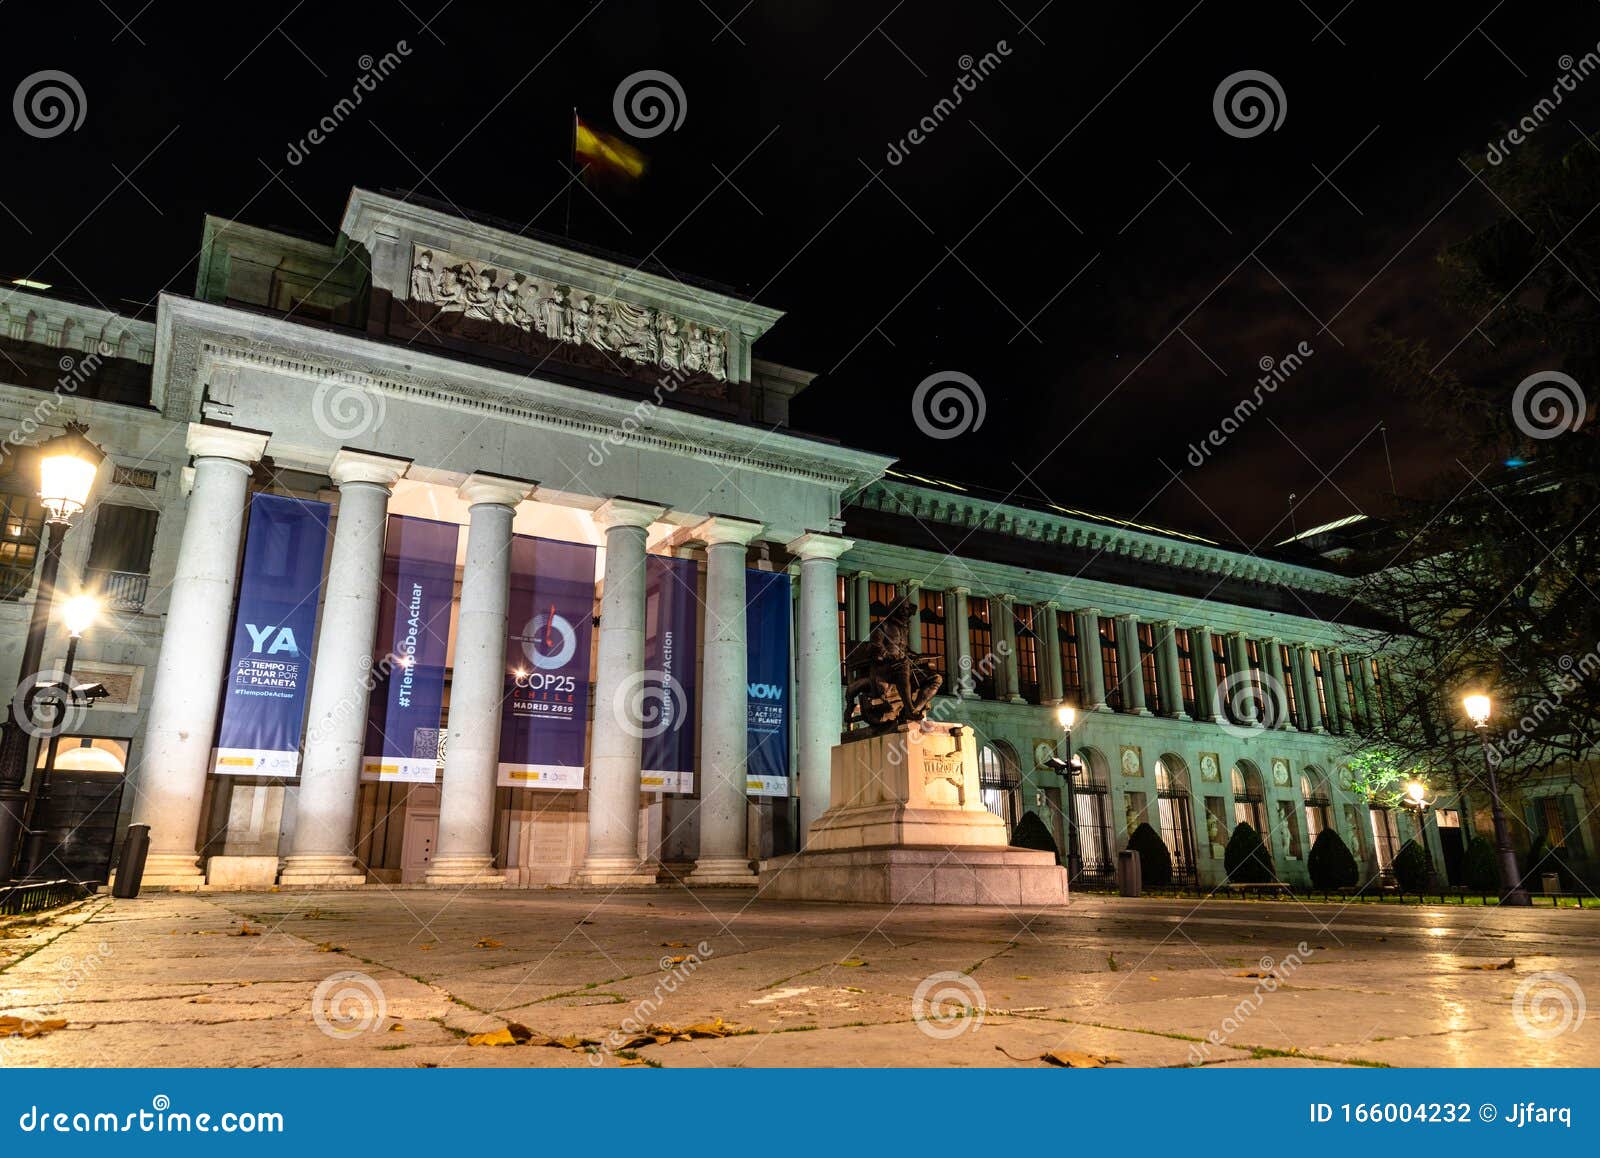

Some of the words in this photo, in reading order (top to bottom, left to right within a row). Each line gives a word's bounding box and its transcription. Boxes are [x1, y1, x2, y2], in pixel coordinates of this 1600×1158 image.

[245, 623, 299, 657] YA
[239, 660, 250, 668] ES
[251, 661, 285, 671] TIEMPO
[237, 669, 276, 677] ACTUAR
[278, 672, 298, 680] POR
[251, 677, 296, 687] PLANETA
[515, 673, 576, 692] COP25
[514, 690, 574, 702] CHILE
[513, 702, 549, 711] MADRID
[551, 705, 573, 713] 2019
